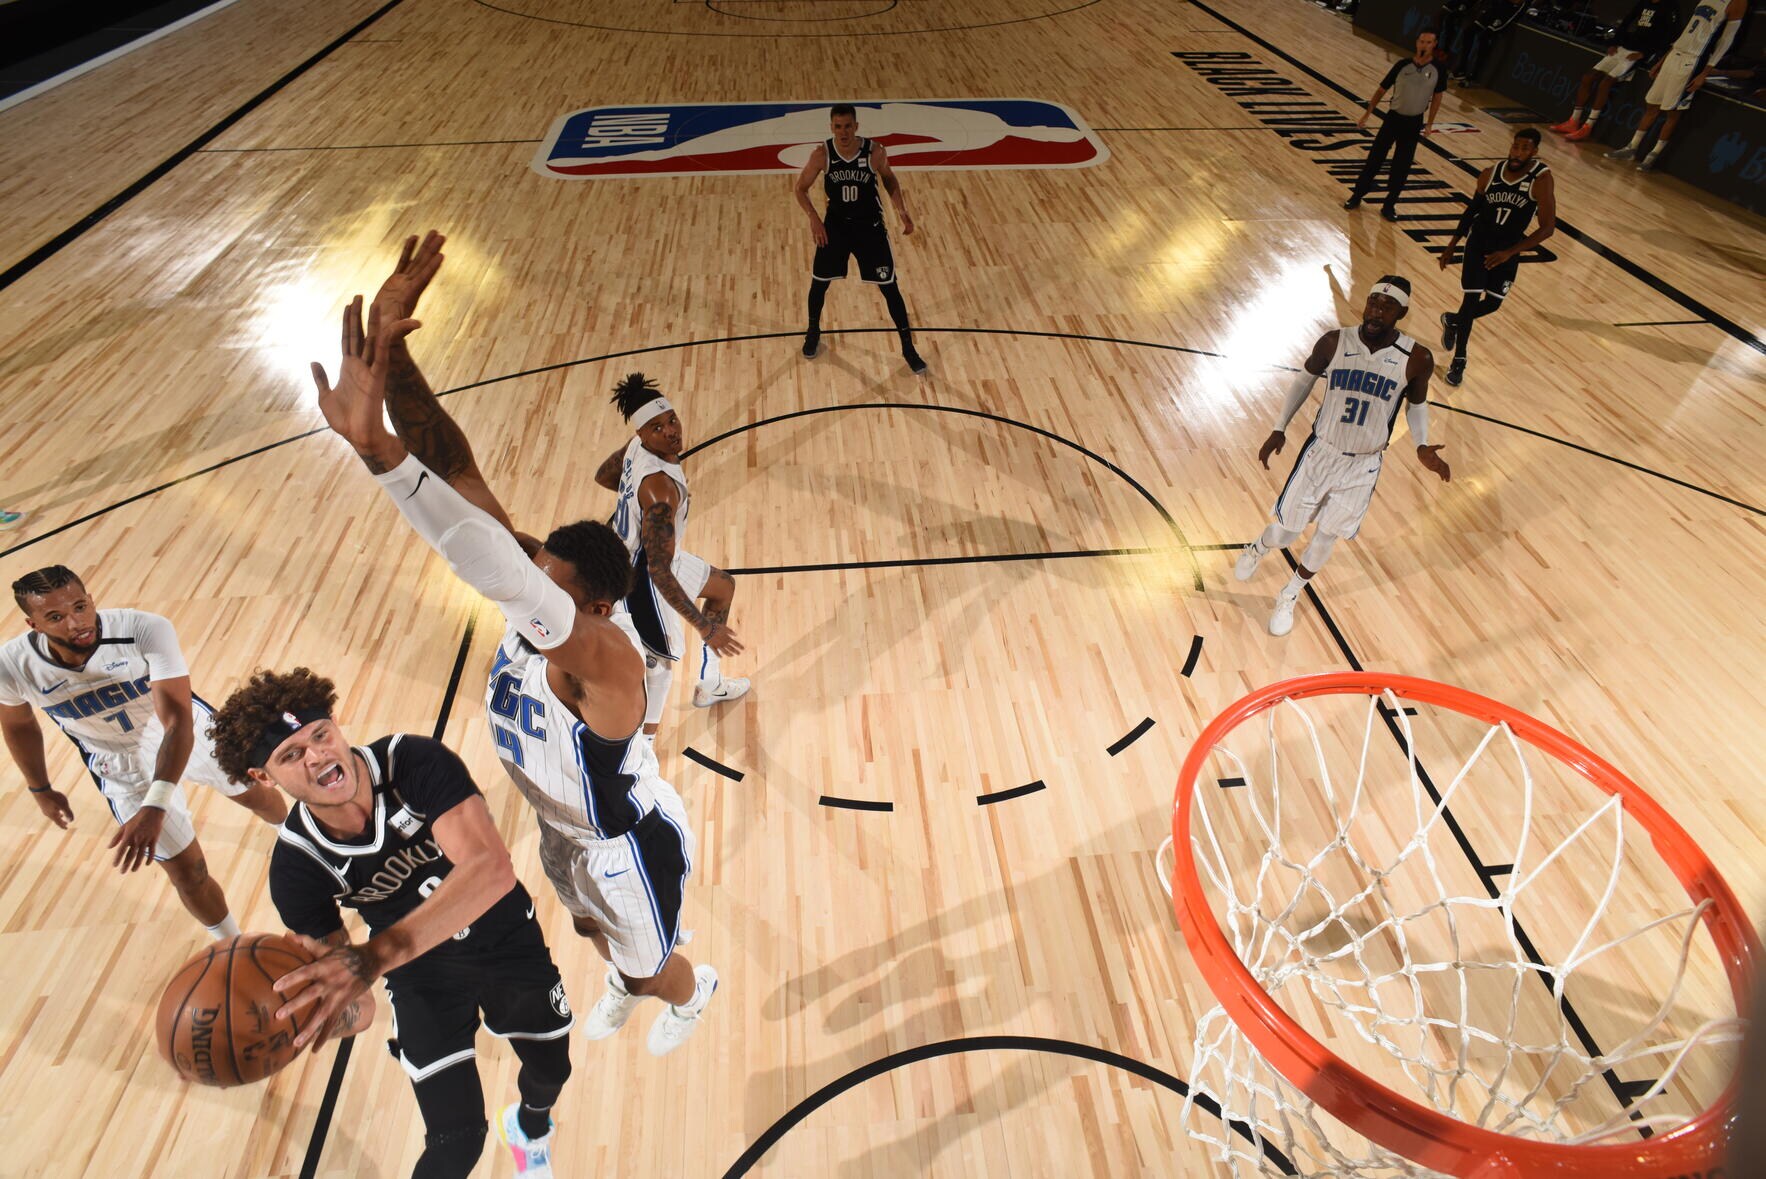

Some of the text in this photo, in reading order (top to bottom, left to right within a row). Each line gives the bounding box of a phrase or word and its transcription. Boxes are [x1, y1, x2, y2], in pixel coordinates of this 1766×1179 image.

[1170, 52, 1313, 96] BLACK
[581, 113, 671, 149] NBA
[1236, 101, 1385, 151] LIVES
[829, 169, 870, 184] BROOKLYN
[841, 185, 858, 202] 00
[1485, 191, 1529, 208] BROOKLYN
[1495, 207, 1511, 225] 17
[1330, 368, 1398, 402] MAGIC
[1340, 397, 1370, 427] 31
[103, 710, 135, 733] 7
